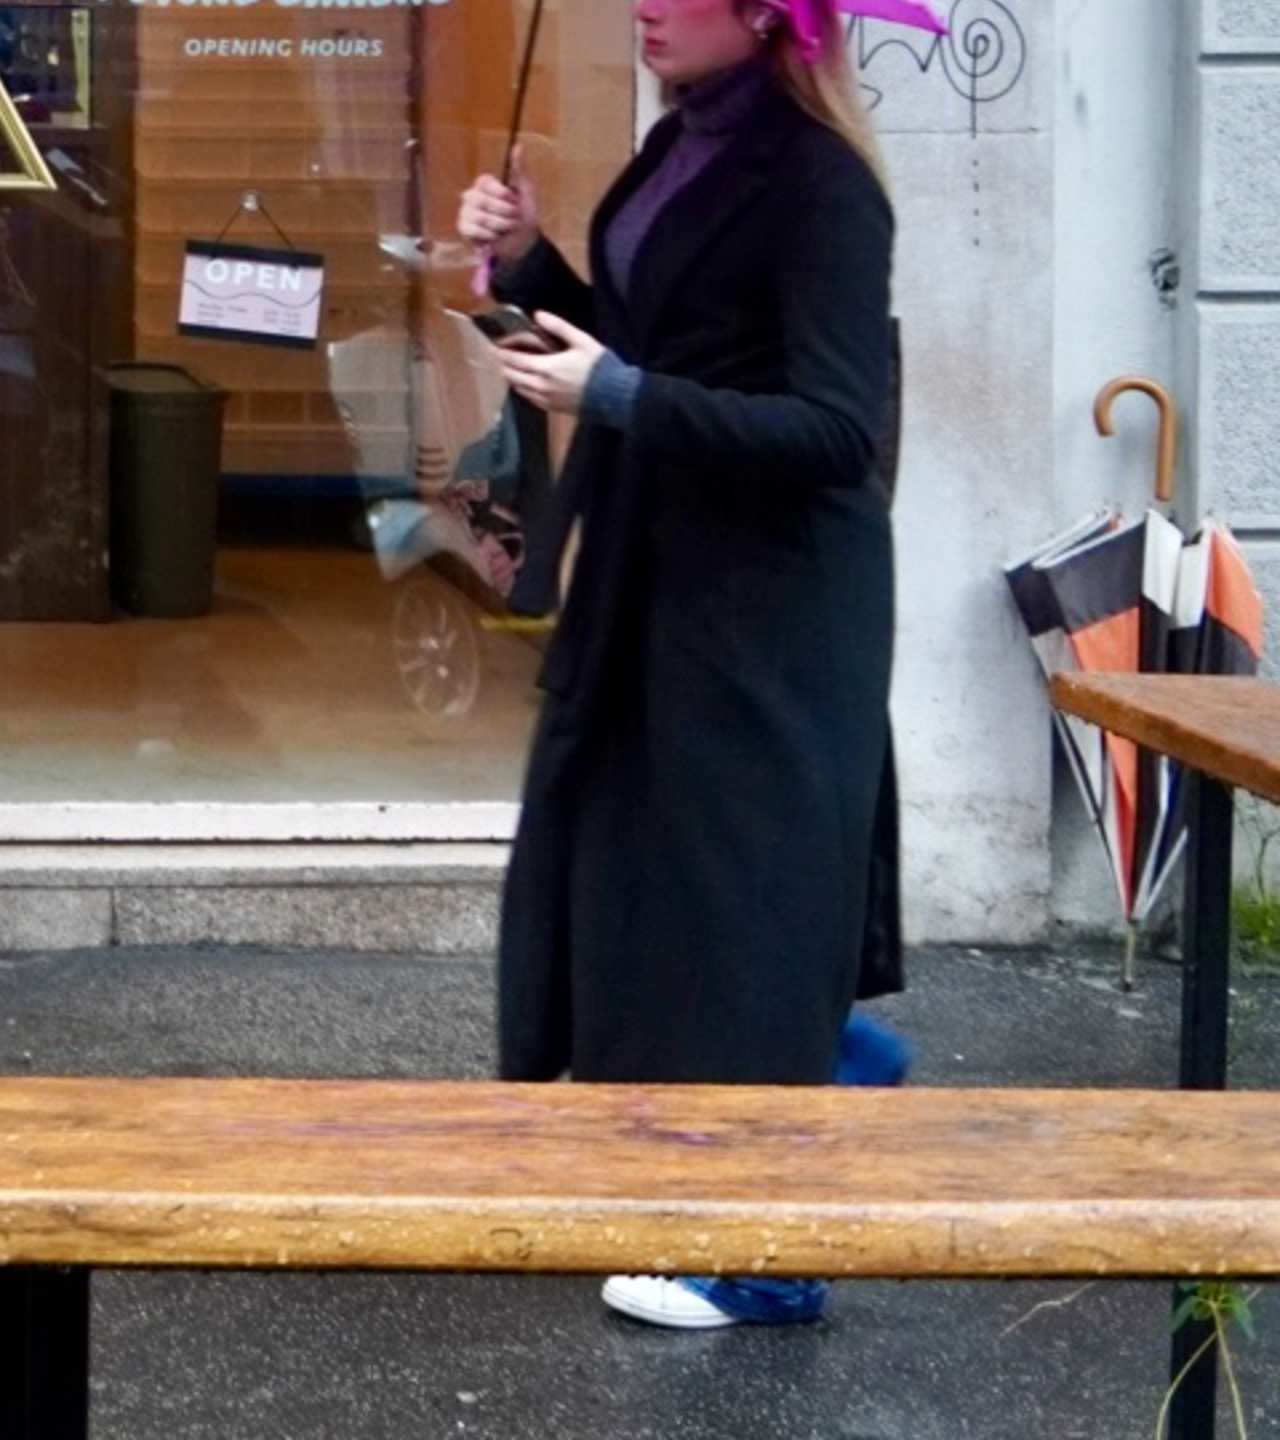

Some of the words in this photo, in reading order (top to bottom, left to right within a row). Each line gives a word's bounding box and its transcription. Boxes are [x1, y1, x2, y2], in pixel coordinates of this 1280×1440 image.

[184, 38, 292, 58] OPENING
[300, 37, 383, 58] HOURS
[205, 258, 303, 292] OPEN
